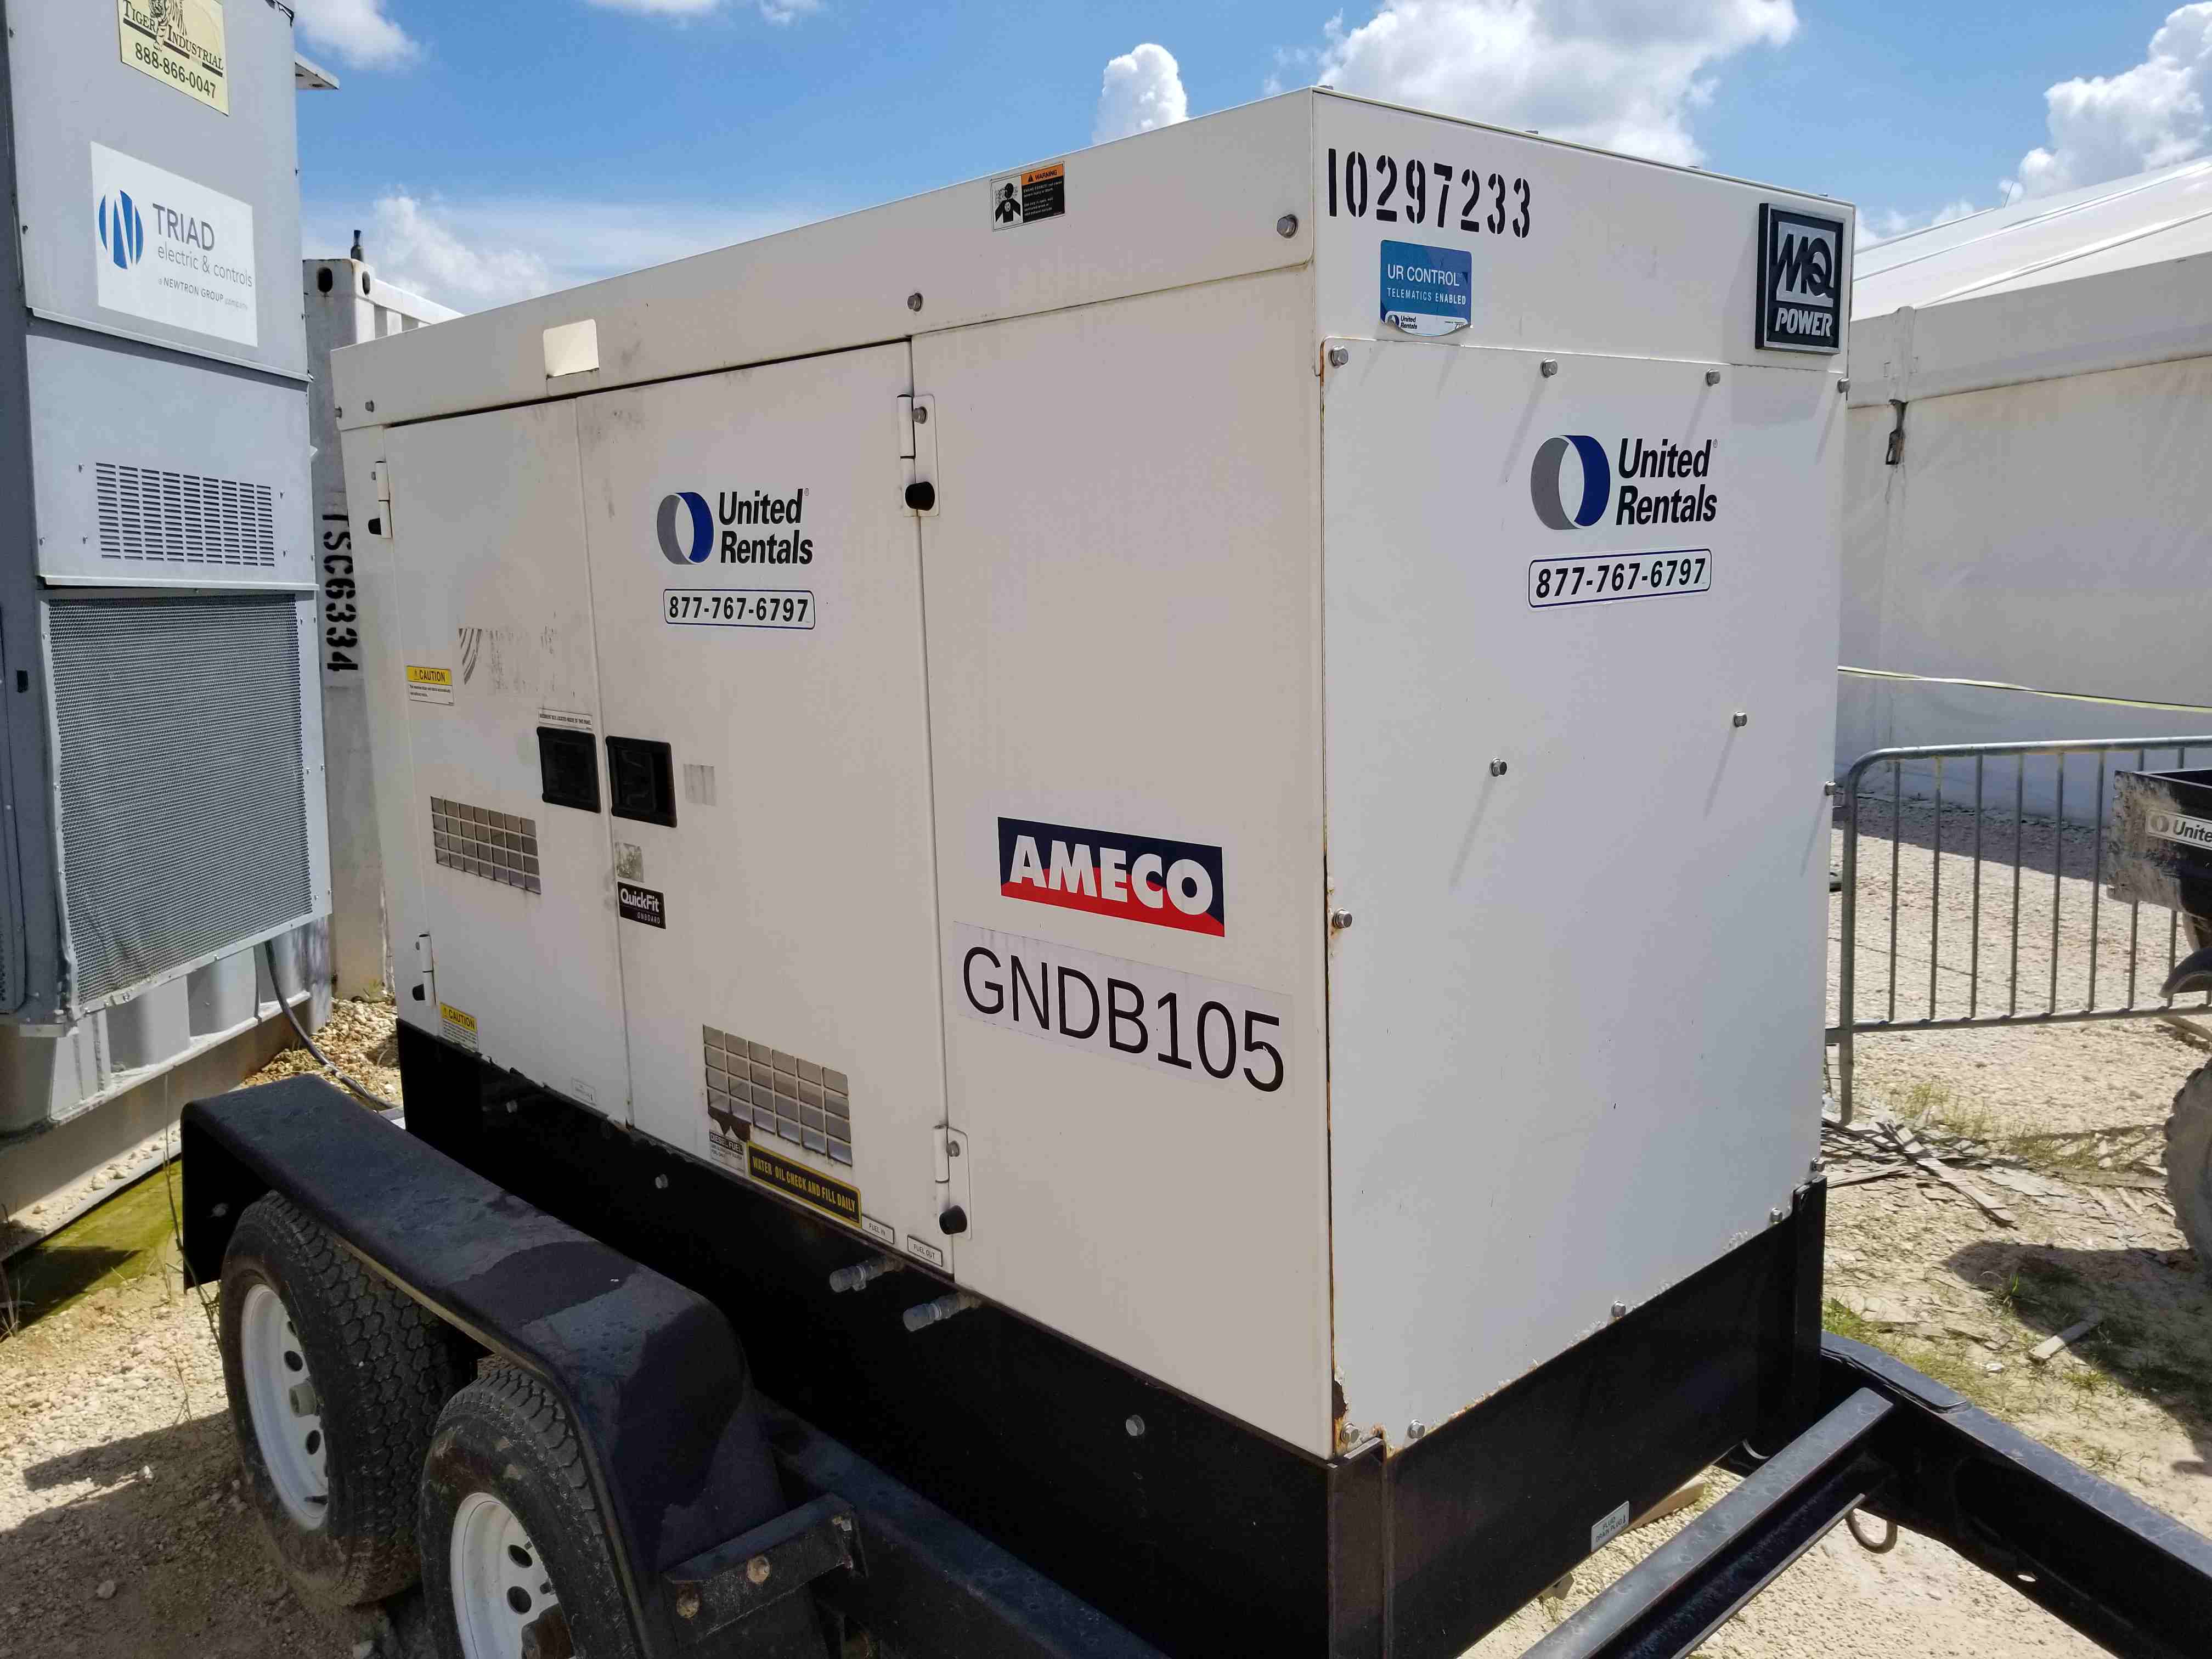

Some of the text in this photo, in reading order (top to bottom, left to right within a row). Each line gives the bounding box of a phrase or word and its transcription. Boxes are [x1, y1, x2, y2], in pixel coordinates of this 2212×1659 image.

[123, 1, 224, 70] TIGER INDUSTRIAL
[135, 43, 216, 98] 888-866-0047
[1035, 170, 1057, 180] WARNING
[1328, 148, 1530, 238] 10297233
[153, 203, 215, 251] TRIAD
[158, 241, 252, 287] electric & controls
[1388, 264, 1459, 286] UR CONTROL
[164, 278, 199, 296] NEWTRON
[201, 289, 224, 301] GROUP
[1387, 288, 1466, 305] TELEMATICS ENABLED
[1775, 308, 1833, 337] POWER
[1618, 438, 1712, 478] United
[719, 489, 803, 525] United
[1616, 484, 1717, 525] Rentals
[720, 530, 813, 565] Rentals
[1536, 558, 1706, 598] 877-767-6797
[669, 596, 808, 622] 877-767-6797
[420, 670, 445, 681] CAUTION
[1009, 835, 1212, 915] AMECO
[620, 888, 659, 912] QuickFit
[637, 912, 660, 924] ONBOARD
[449, 1009, 474, 1029] CAUTION
[963, 947, 1284, 1092] GNDB105
[711, 1133, 728, 1147] DIESEL
[729, 1142, 742, 1153] FUEL
[752, 1156, 855, 1212] WATER OIL CHECK AND FILL DAILY
[870, 1223, 879, 1233] FUEL
[913, 1244, 935, 1259] FUEL OUT
